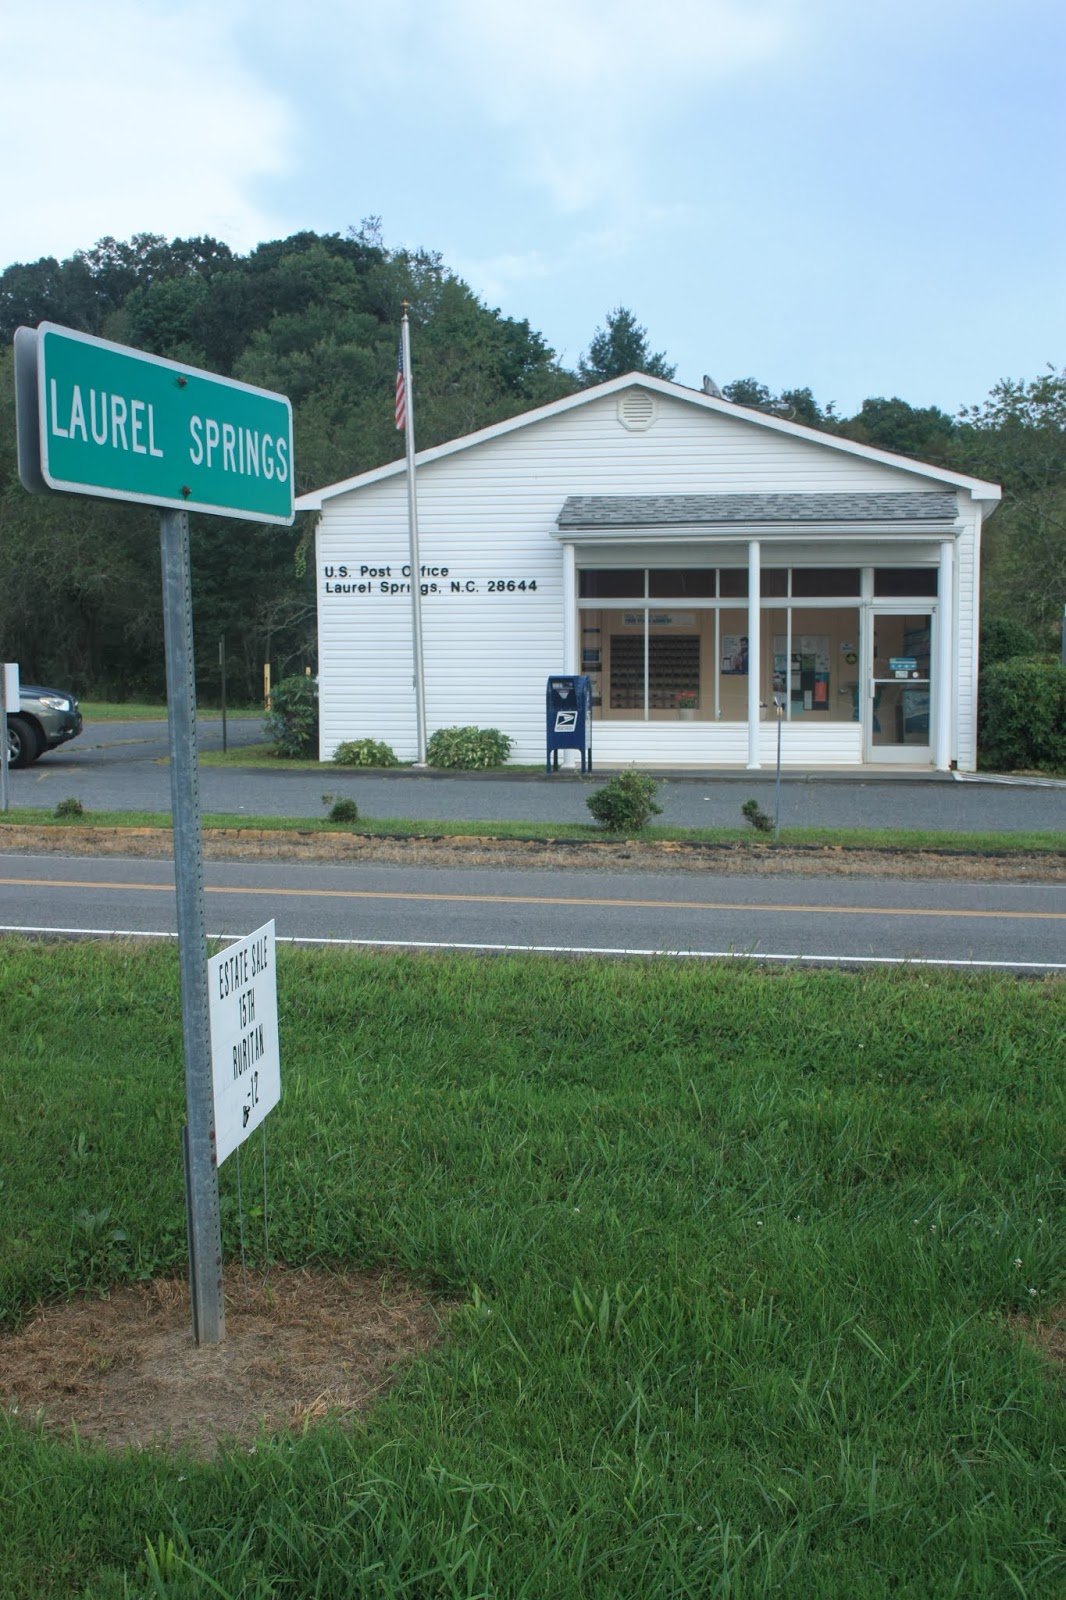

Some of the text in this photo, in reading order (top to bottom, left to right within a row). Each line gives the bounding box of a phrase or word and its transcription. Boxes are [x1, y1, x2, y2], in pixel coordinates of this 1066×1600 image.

[50, 378, 288, 483] LAUREL SPRINGS
[324, 565, 449, 577] U.S. Post Ofice
[325, 580, 538, 596] Laurel Sprigs, N.C. 28644
[219, 935, 267, 1000] ESTATE SALE
[232, 1023, 264, 1080] RURITAN
